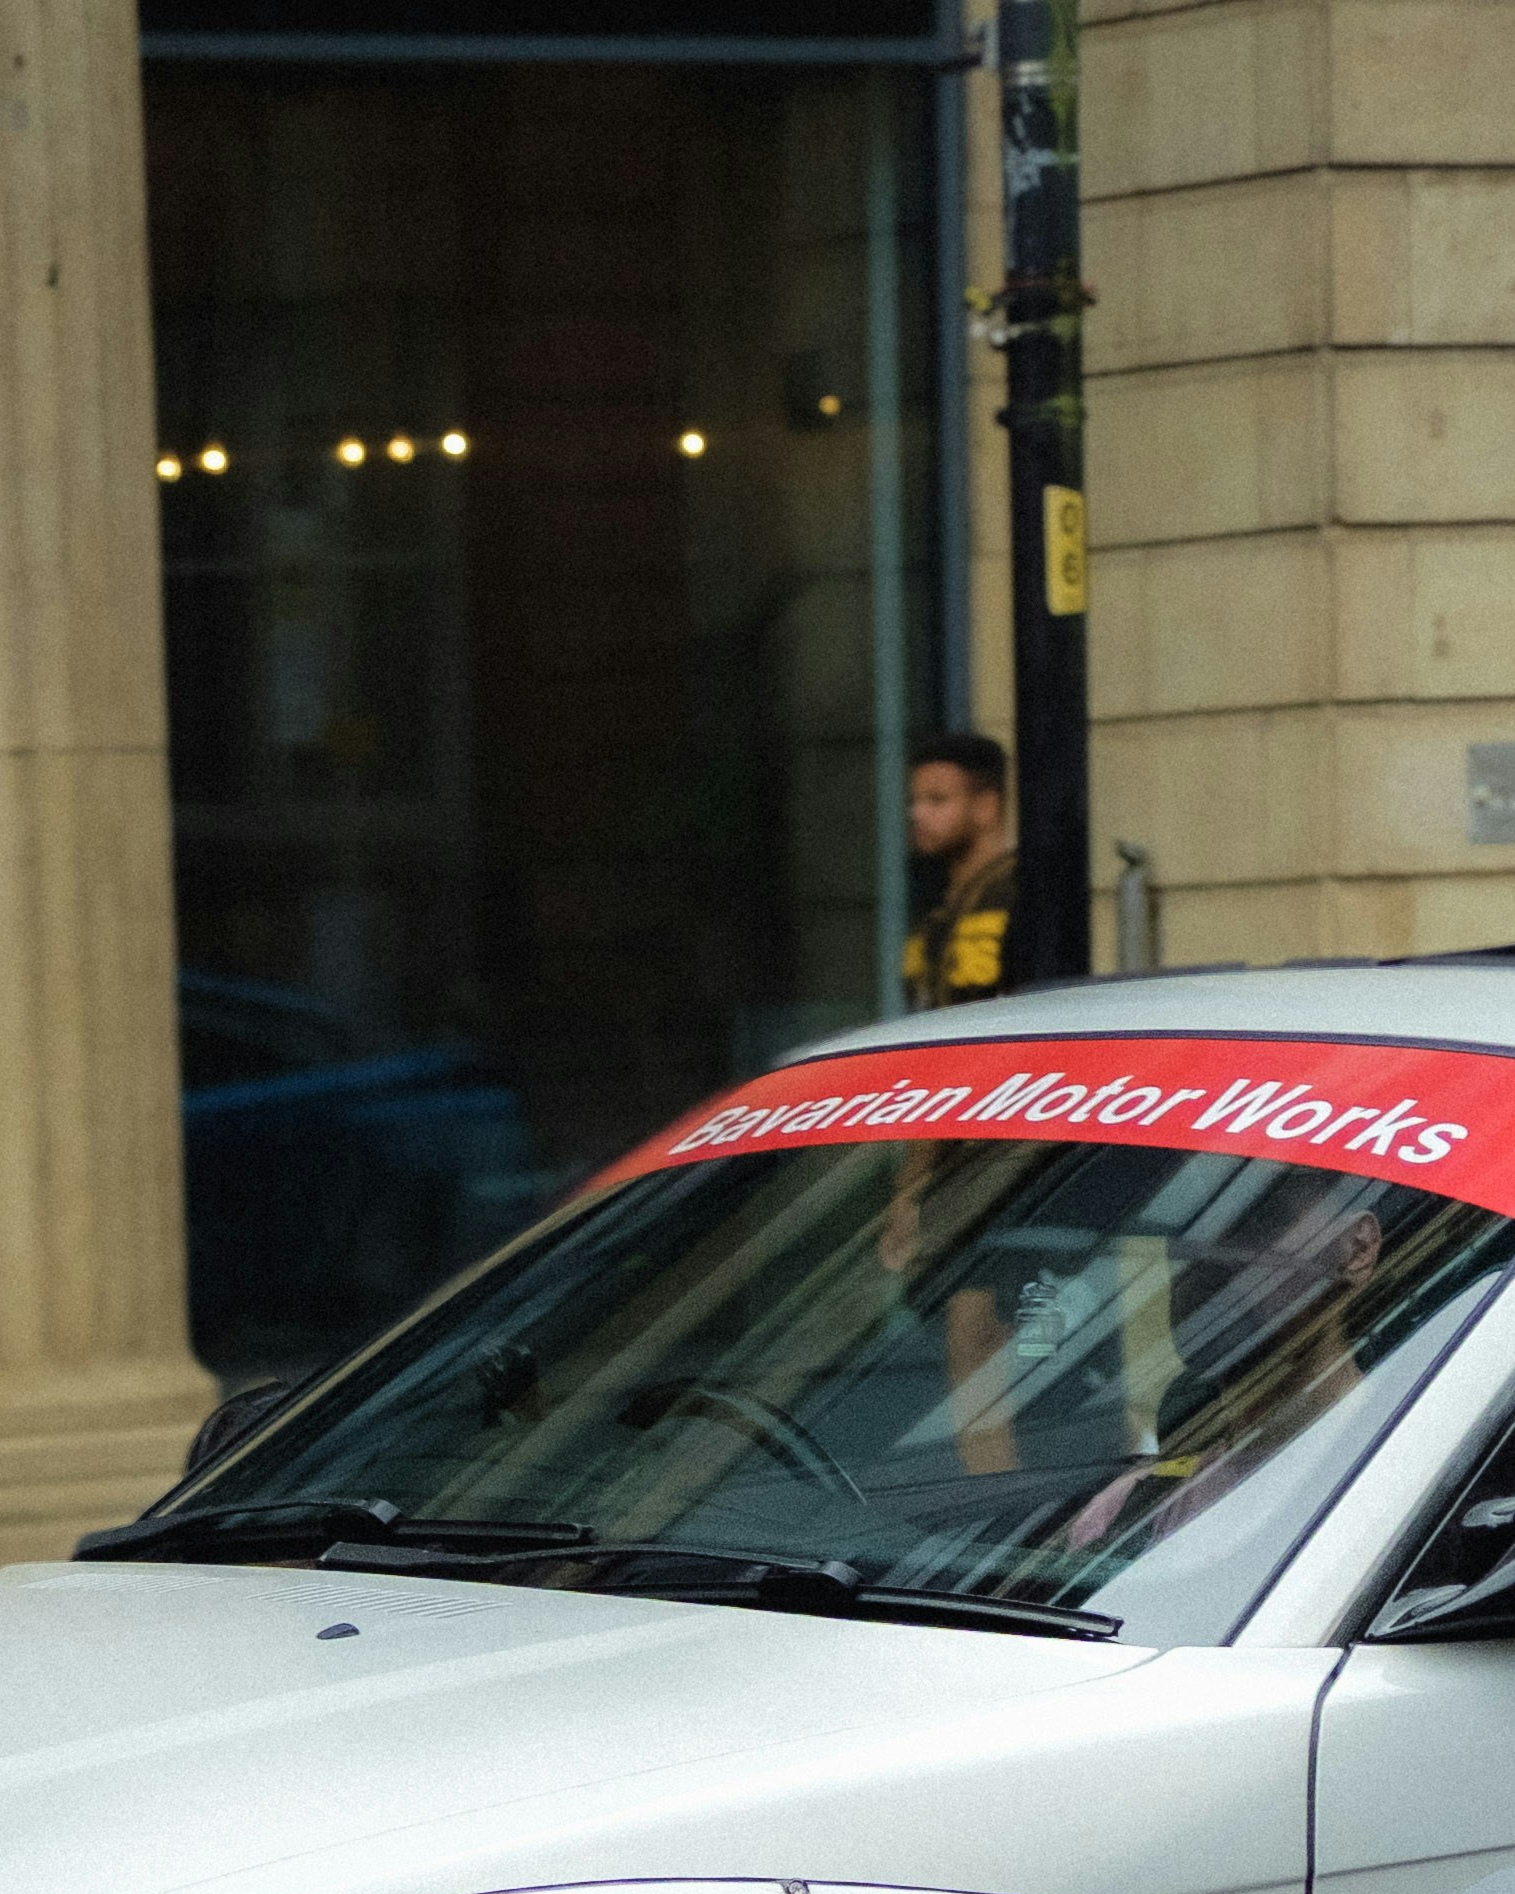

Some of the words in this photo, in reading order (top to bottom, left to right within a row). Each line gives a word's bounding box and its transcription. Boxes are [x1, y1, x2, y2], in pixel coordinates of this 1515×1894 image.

[668, 1079, 973, 1155] Bavarian
[957, 1072, 1206, 1126] Motor
[1191, 1078, 1469, 1164] Works
